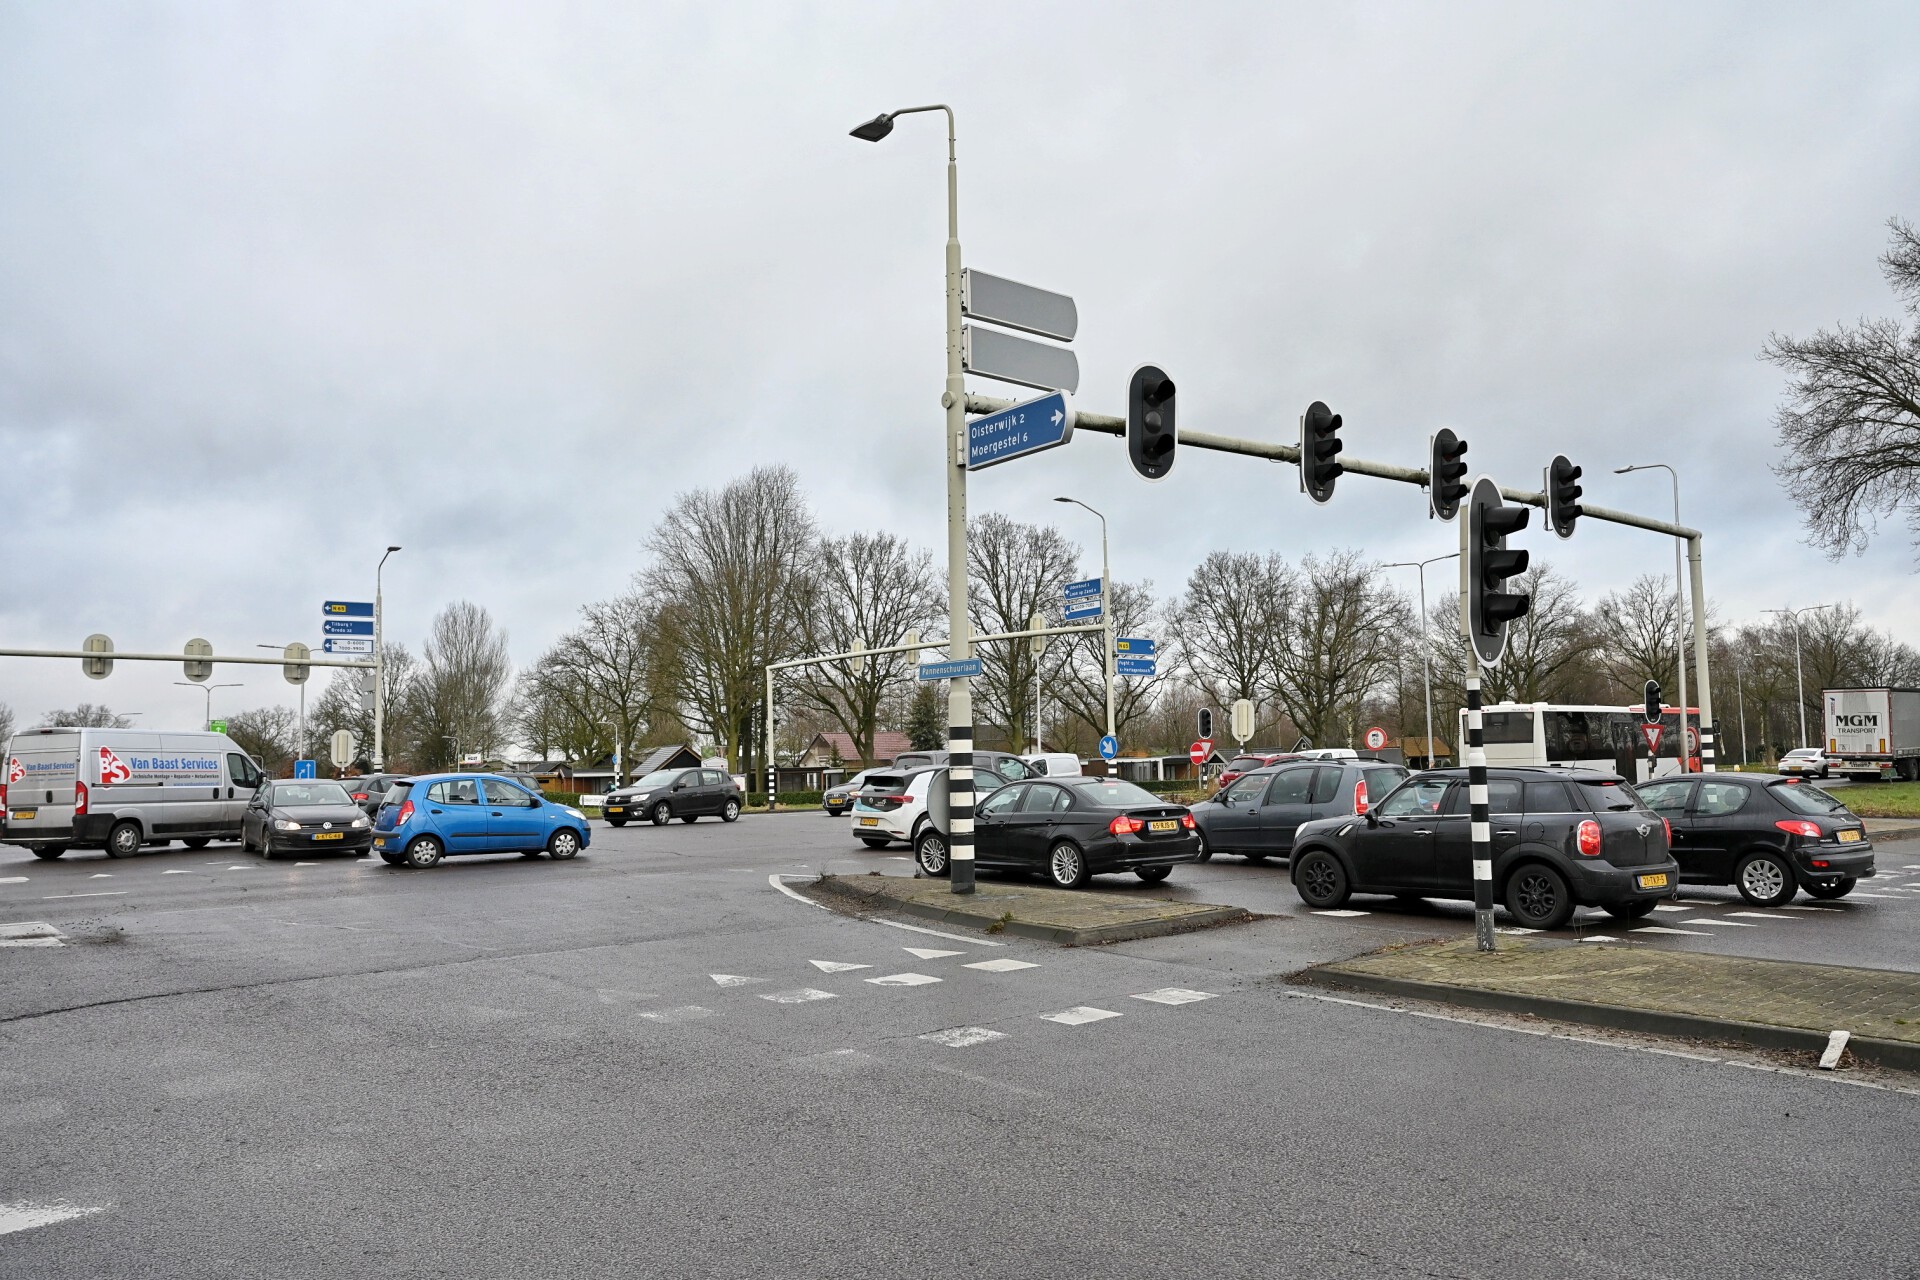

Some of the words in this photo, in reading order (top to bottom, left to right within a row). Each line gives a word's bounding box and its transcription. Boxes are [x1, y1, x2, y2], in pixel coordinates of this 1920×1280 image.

[971, 415, 1017, 439] Oisterwijk
[1019, 413, 1025, 423] 2
[971, 432, 1020, 458] Moergestel
[1022, 432, 1028, 442] 6
[922, 663, 977, 676] Pannenschuurlaan
[1835, 714, 1878, 727] MGM
[26, 763, 36, 771] Van
[37, 762, 52, 770] Baast
[53, 761, 75, 770] Services
[130, 757, 149, 770] Van
[152, 757, 179, 770] Baast
[181, 757, 218, 770] Services
